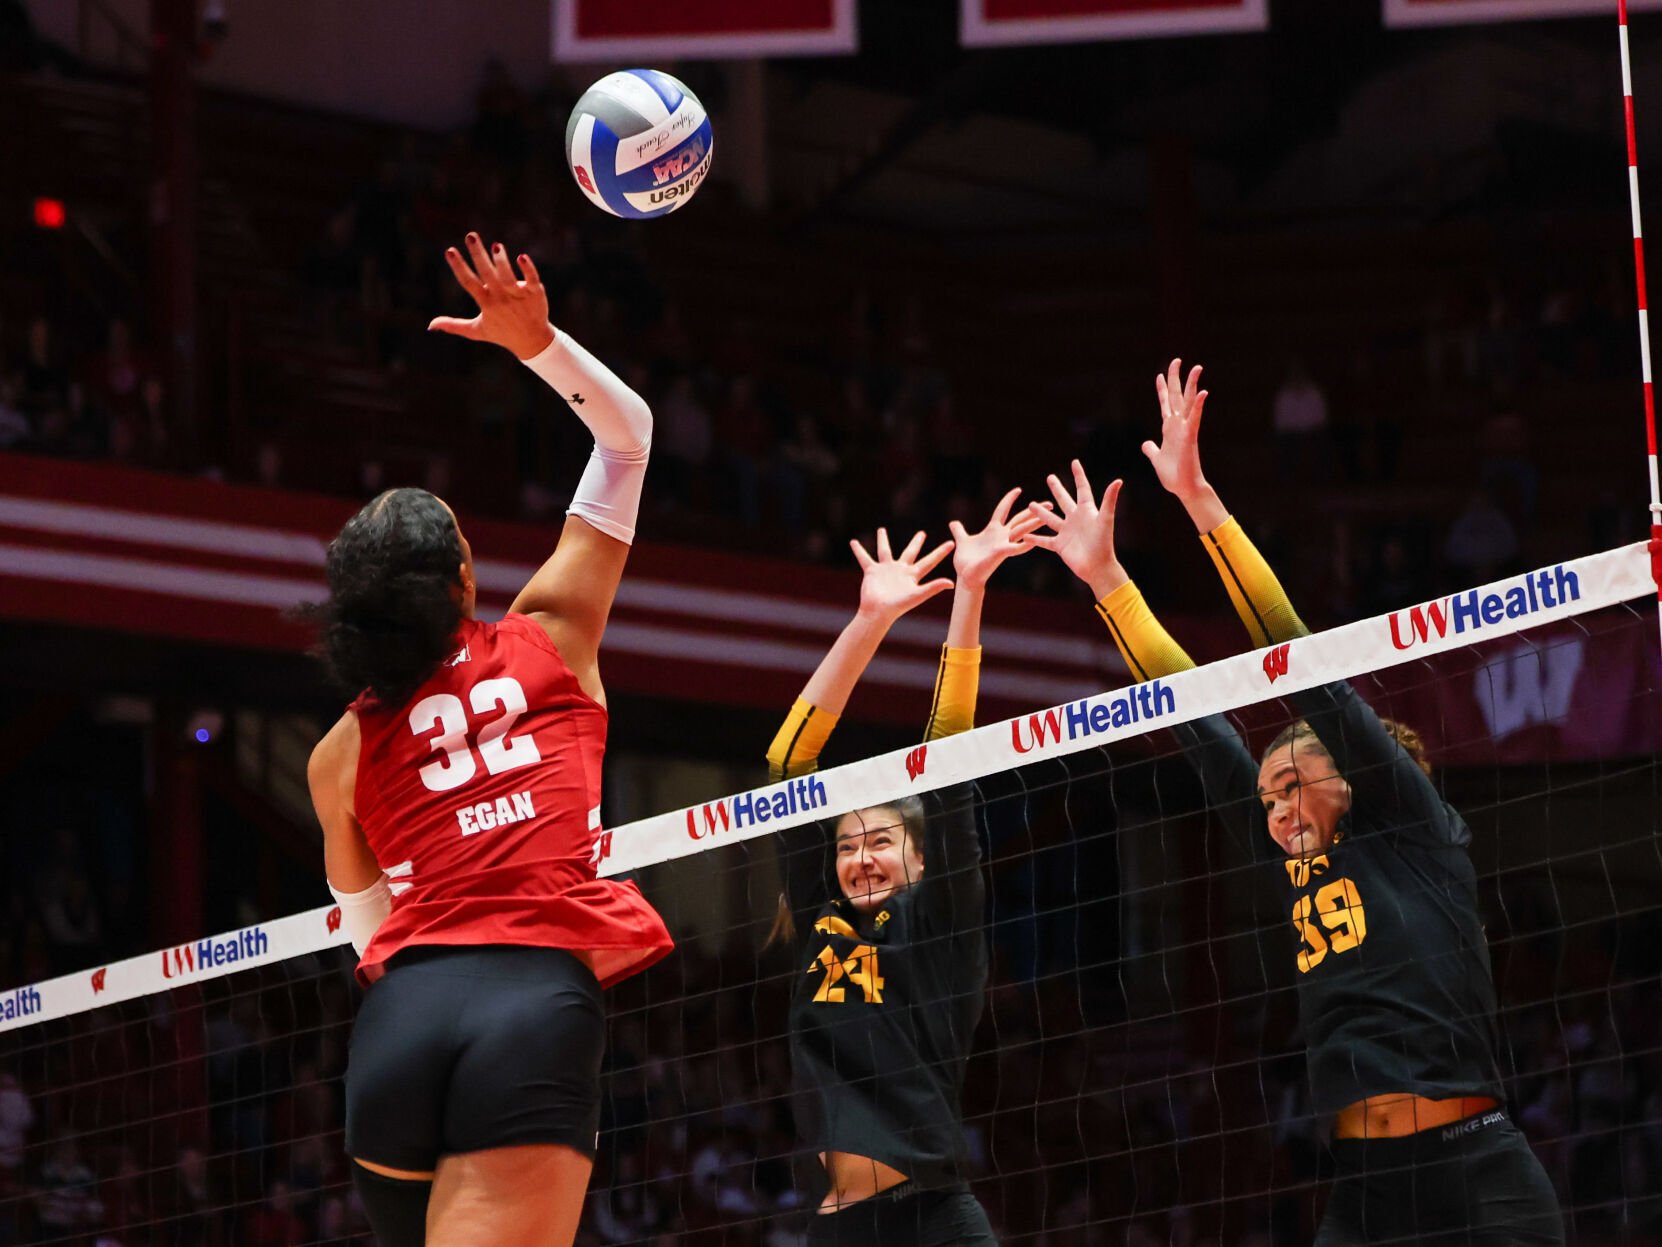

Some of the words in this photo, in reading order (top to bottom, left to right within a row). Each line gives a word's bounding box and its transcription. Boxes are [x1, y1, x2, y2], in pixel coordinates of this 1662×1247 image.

[650, 154, 711, 204] molten
[653, 135, 705, 185] NCAA
[408, 676, 542, 793] 32
[455, 790, 536, 837] EGAN
[1292, 877, 1367, 974] 39
[806, 944, 885, 1004] 24
[1441, 1119, 1480, 1142] NIKE
